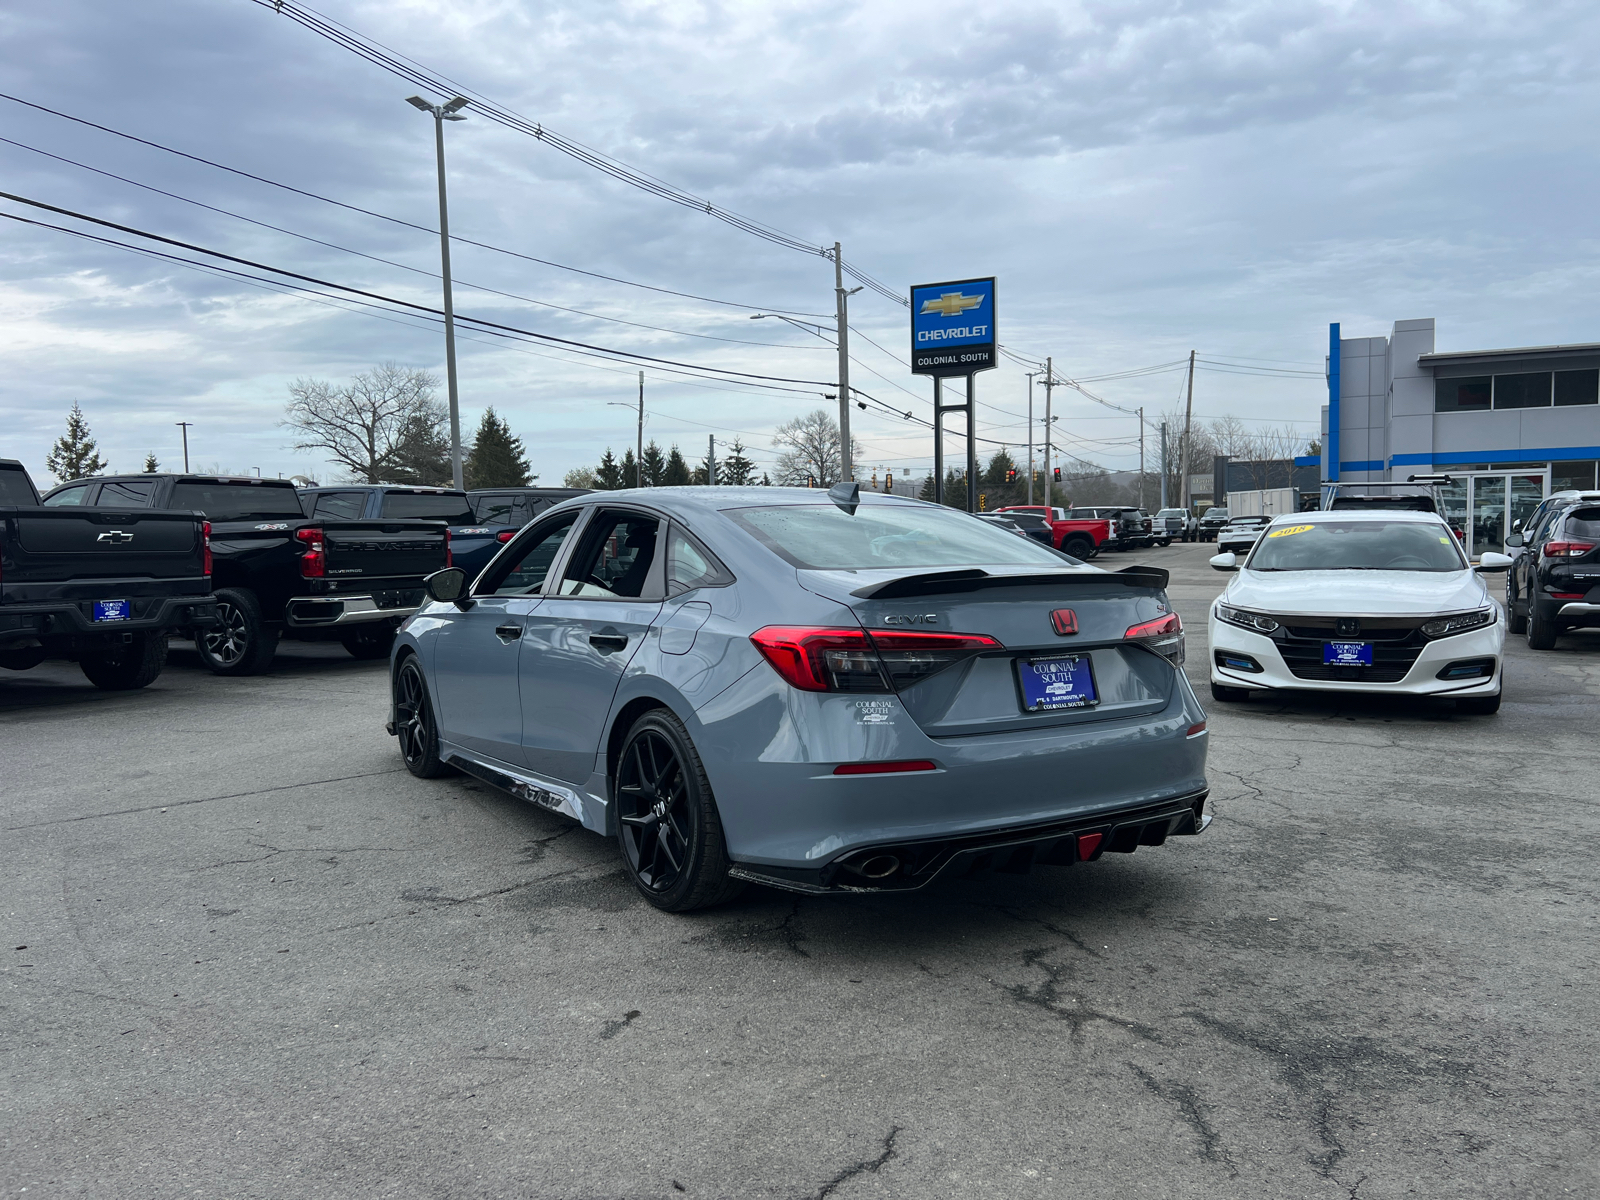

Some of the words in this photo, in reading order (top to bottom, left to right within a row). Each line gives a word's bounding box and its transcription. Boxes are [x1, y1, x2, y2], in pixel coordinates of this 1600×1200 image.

[918, 325, 988, 342] CHEVROLET
[918, 355, 958, 366] COLONIAL
[960, 352, 989, 362] SOUTH
[1276, 525, 1307, 537] 2018
[334, 541, 442, 552] CHEVROLET
[884, 613, 938, 625] CIVIC
[1033, 662, 1077, 675] COLONIAL
[1041, 672, 1073, 683] SOUTH
